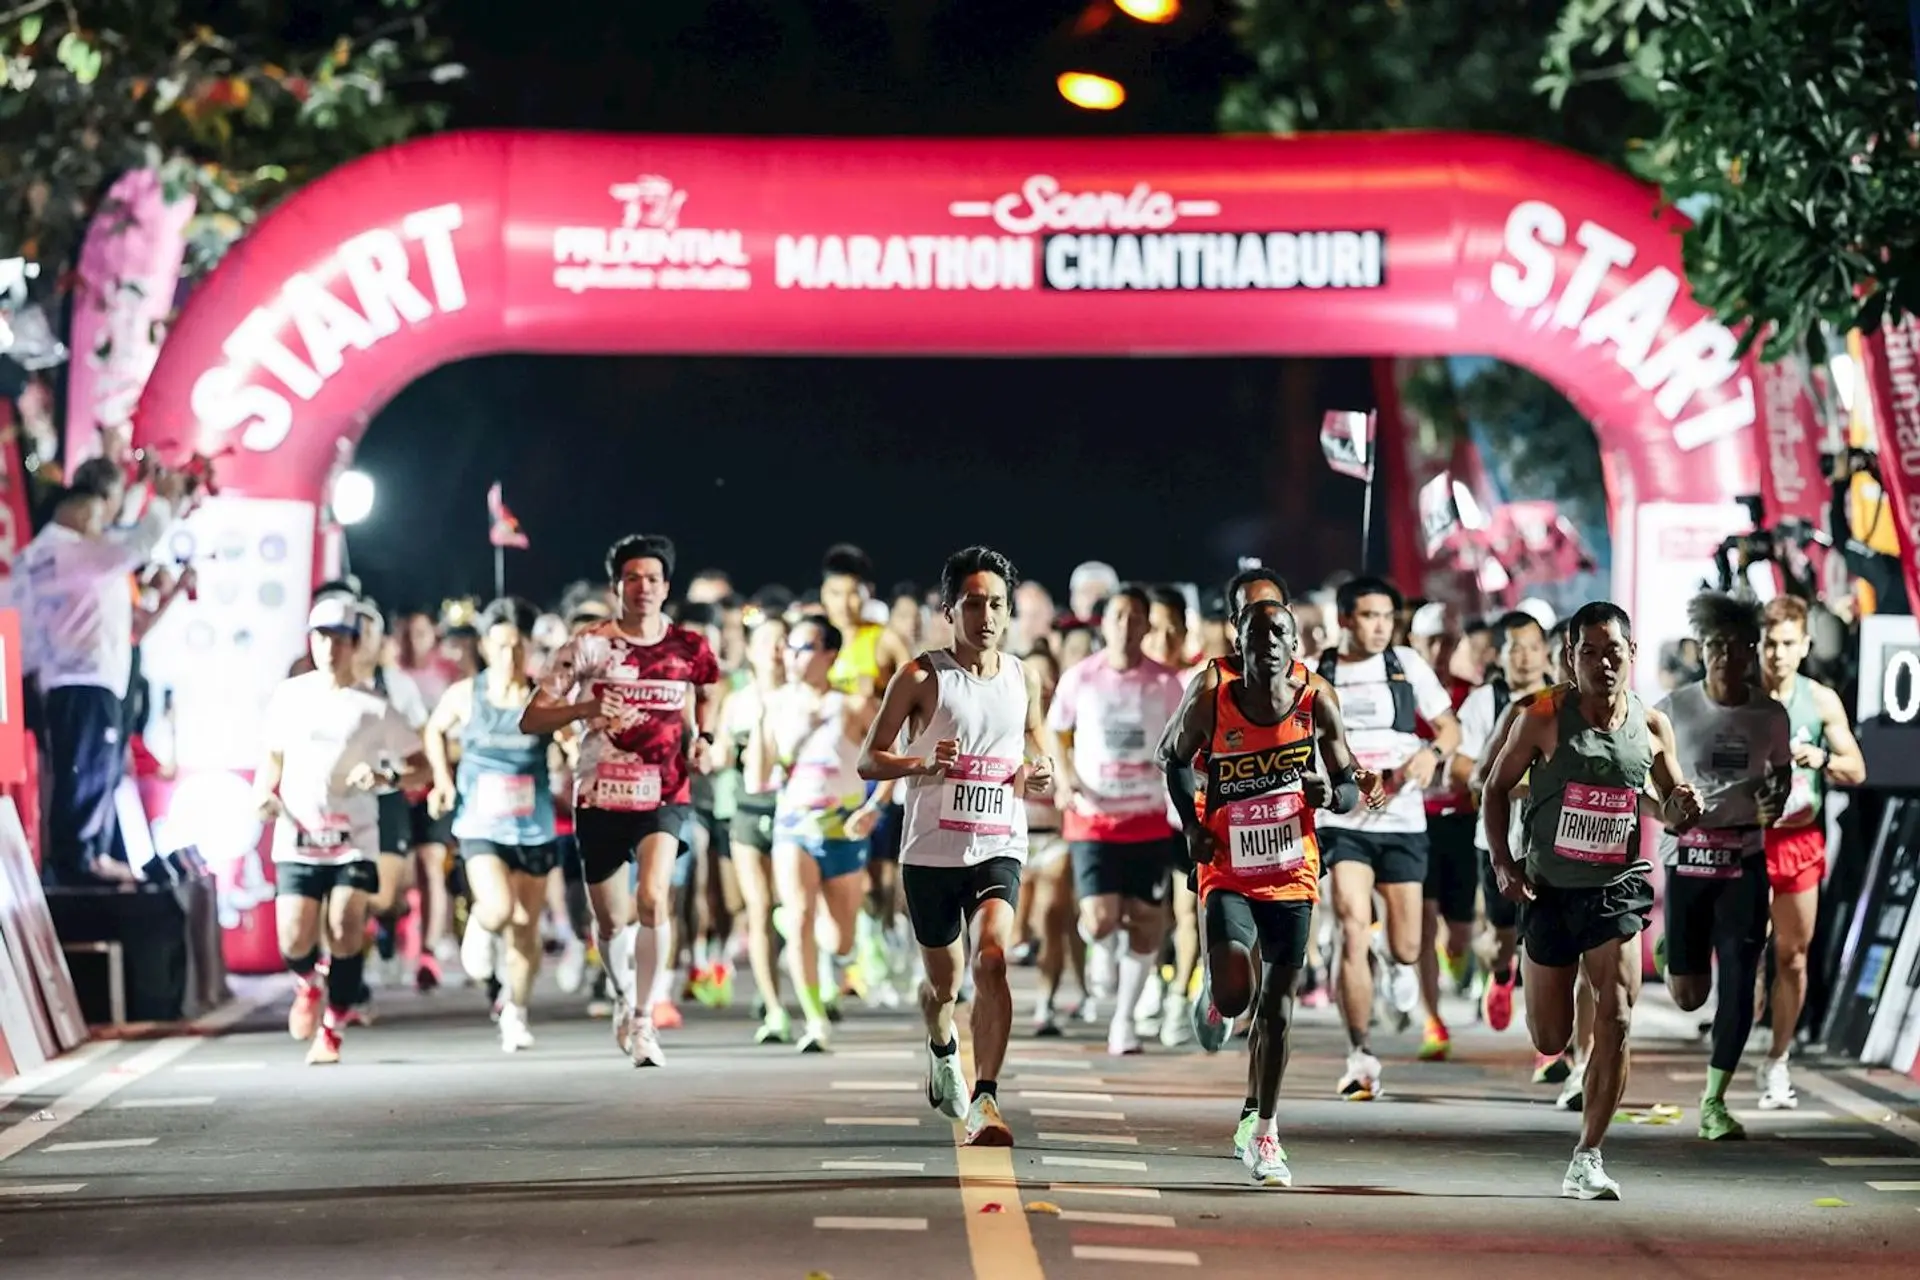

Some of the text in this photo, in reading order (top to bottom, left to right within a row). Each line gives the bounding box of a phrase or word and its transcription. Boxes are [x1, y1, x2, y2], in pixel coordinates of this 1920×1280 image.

[993, 174, 1177, 233] Scenic
[775, 233, 1034, 291] MARATHON
[1044, 231, 1383, 290] CHANTHABURI
[191, 203, 468, 453] START
[1490, 200, 1757, 452] START
[953, 783, 1004, 815] RYOTA
[1220, 774, 1276, 794] ENERGY
[1240, 823, 1293, 857] MUHIA
[1561, 811, 1630, 844] TANWARAT
[1687, 847, 1732, 865] PACER
